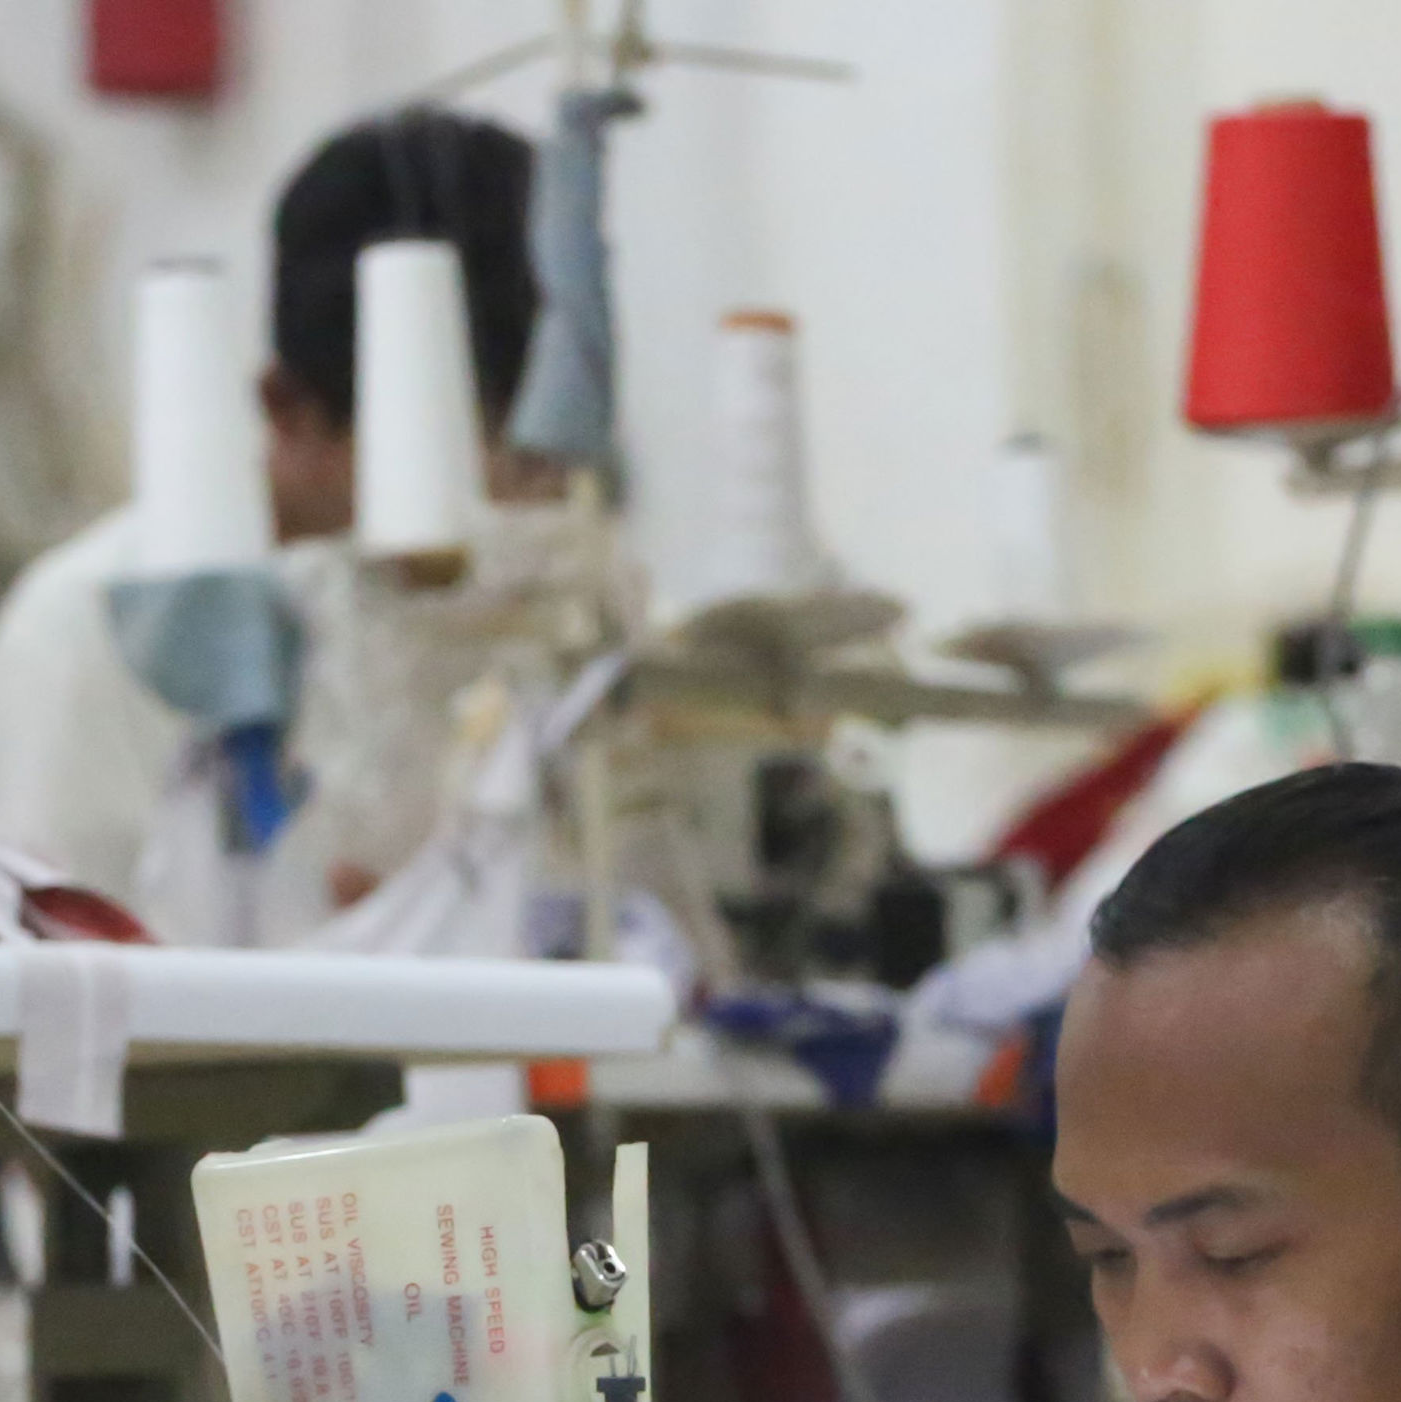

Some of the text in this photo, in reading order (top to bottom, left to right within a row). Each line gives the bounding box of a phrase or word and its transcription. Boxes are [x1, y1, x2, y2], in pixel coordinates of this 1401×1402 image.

[288, 1201, 307, 1244] SUS
[316, 1196, 335, 1240] SUS
[296, 1256, 312, 1278] AT
[324, 1252, 340, 1275] AT
[341, 1192, 373, 1347] OIL VISCOSITY
[404, 1282, 422, 1322] OIL
[437, 1204, 470, 1386] SEWING MACHINE
[480, 1225, 505, 1354] HIGH SPEED
